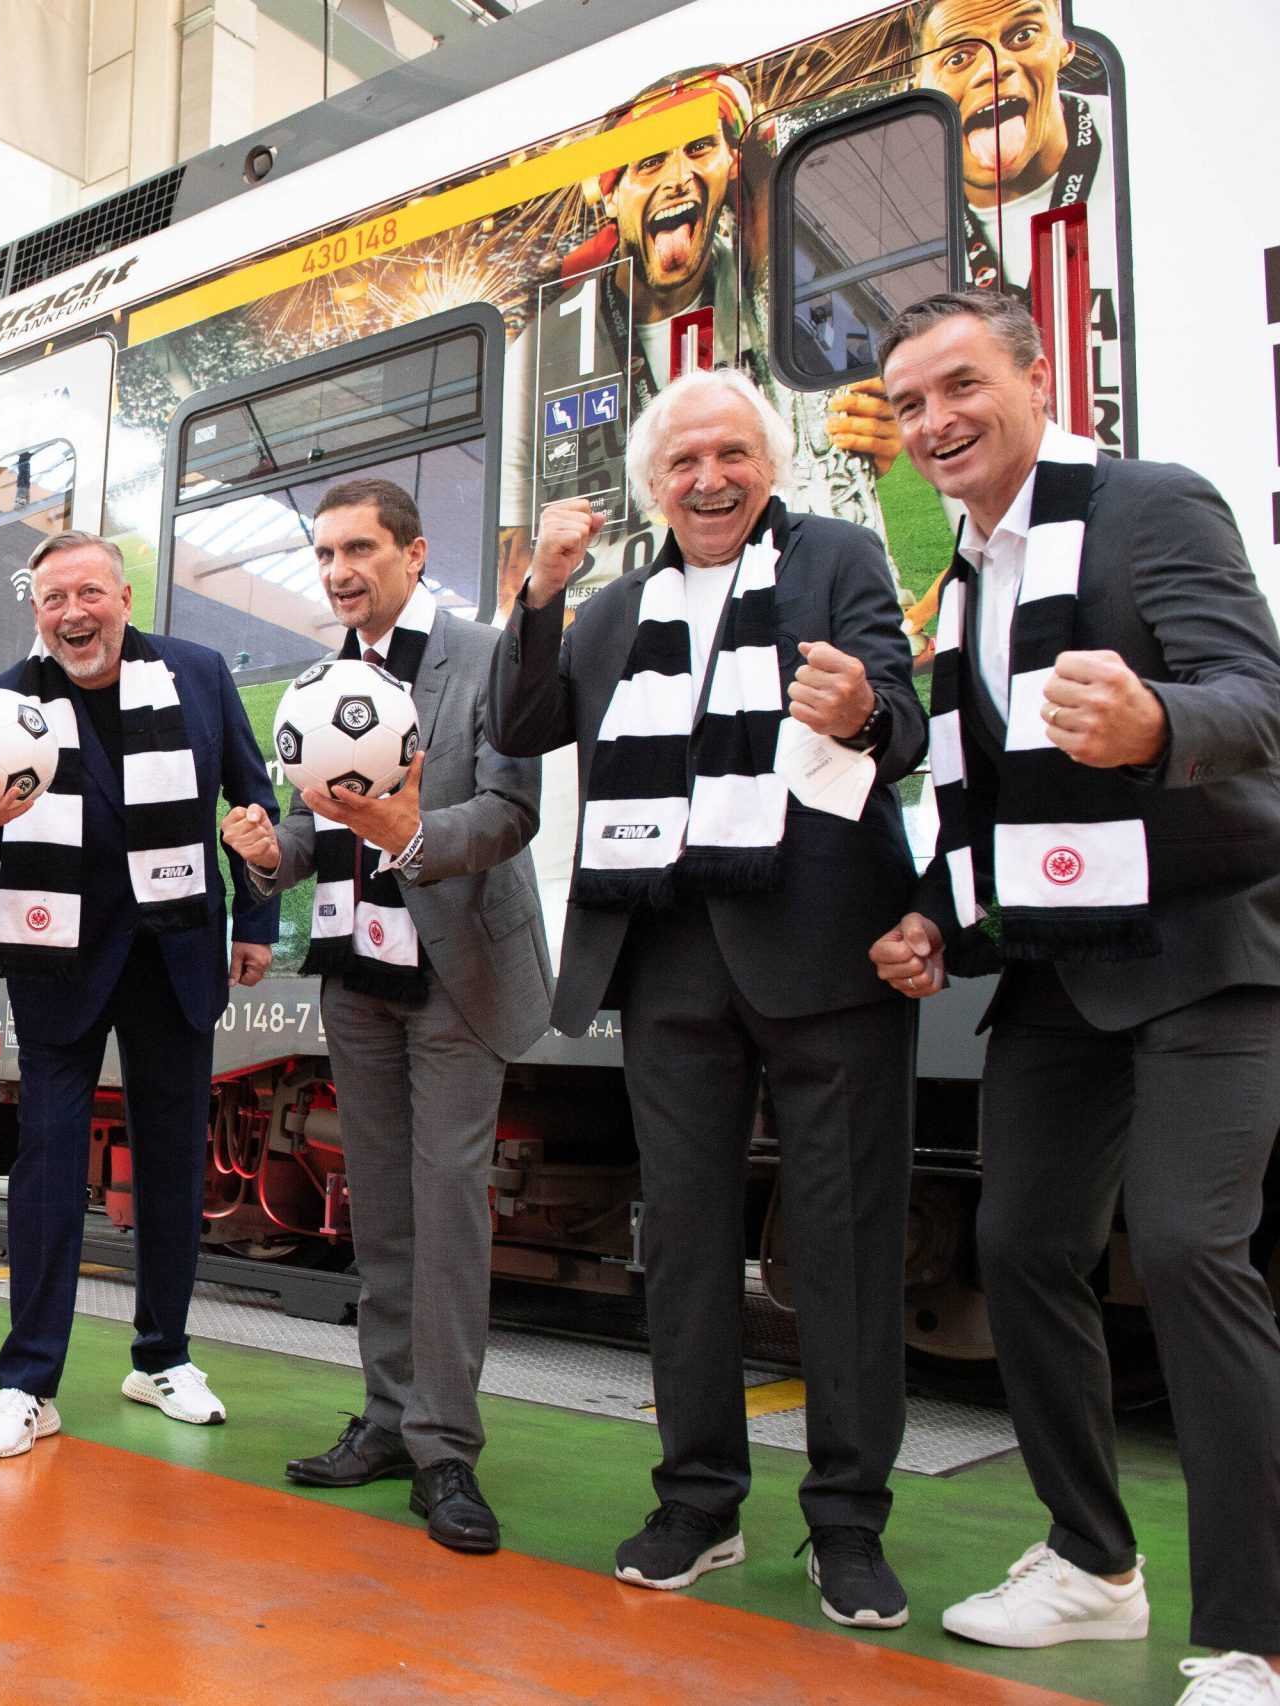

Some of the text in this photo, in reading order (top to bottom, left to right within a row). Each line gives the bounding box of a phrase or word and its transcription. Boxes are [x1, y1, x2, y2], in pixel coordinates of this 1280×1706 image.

[301, 218, 397, 273] 430 148
[559, 277, 597, 377] 1
[590, 498, 605, 507] mit
[612, 824, 658, 839] RMV
[158, 865, 191, 879] RMV
[243, 1002, 312, 1033] 148-7
